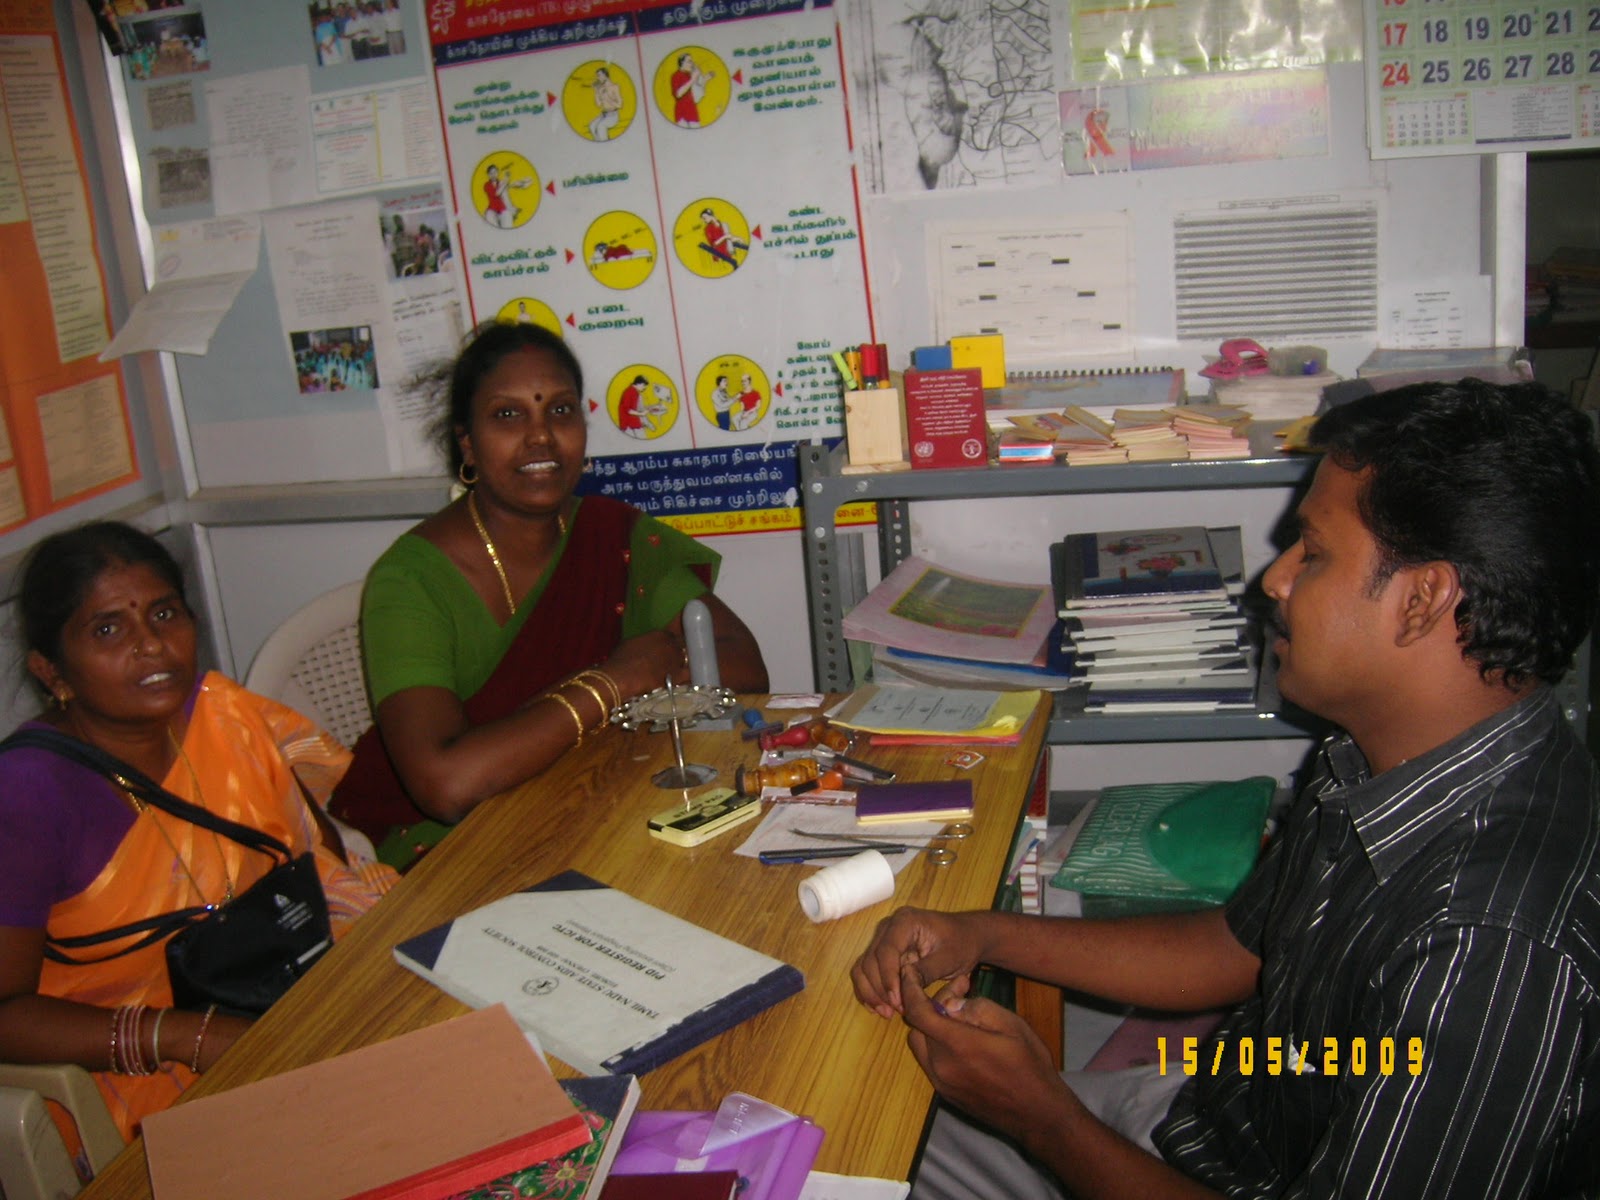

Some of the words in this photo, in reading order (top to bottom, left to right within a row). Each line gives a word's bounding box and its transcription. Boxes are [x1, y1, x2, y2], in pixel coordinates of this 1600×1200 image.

[1383, 23, 1408, 47] 17
[1424, 19, 1449, 44] 18
[1465, 17, 1490, 41] 19
[1504, 13, 1532, 38] 20
[1545, 10, 1572, 34] 21
[1588, 7, 1600, 32] 2
[1382, 62, 1410, 88] 24
[1422, 60, 1450, 84] 25
[1463, 58, 1492, 82] 26
[1504, 55, 1533, 79] 27
[1546, 51, 1575, 76] 28
[1588, 49, 1600, 74] 2
[788, 248, 834, 259] டாது
[621, 456, 668, 475] ஆரம்ப
[672, 453, 727, 468] சுகாதார
[732, 444, 797, 465] நிலையங்
[601, 481, 634, 494] அரசு
[663, 494, 722, 509] சிகிச்சை
[728, 488, 790, 508] முற்றிலு
[552, 923, 571, 936] ICTC
[575, 934, 595, 948] FOR
[517, 945, 556, 967] CONTROL
[595, 942, 643, 972] REGISTER
[555, 965, 574, 978] AIDS
[644, 966, 666, 980] PID
[576, 974, 602, 992] STATE
[602, 985, 632, 1005] NADU
[632, 1000, 660, 1019] TAMIL
